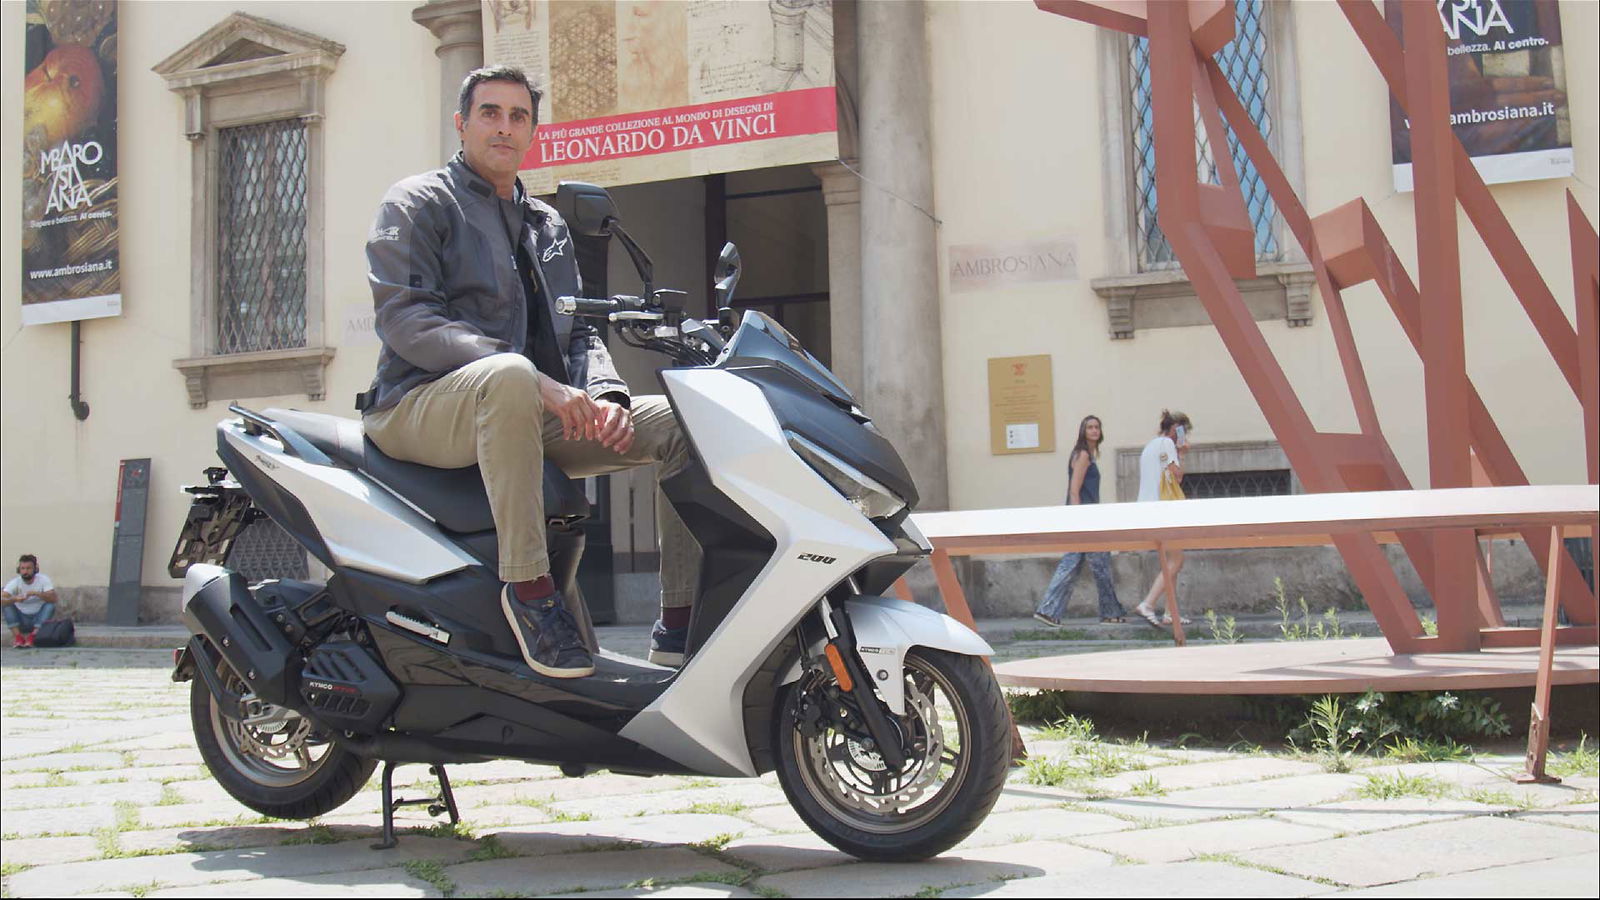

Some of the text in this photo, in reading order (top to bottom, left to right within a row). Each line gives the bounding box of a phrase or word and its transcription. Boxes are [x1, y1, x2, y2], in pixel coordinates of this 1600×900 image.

[1447, 37, 1549, 56] bellezza. Al centro.
[538, 101, 774, 141] LA PIÙ GRANDE COLLEZIONE AL MONDO DI DISEGNI DI
[1405, 102, 1555, 129] ambrosiana.it
[540, 112, 777, 163] LEONARDO DA VINCI
[30, 260, 113, 280] www.ambrosiana.it
[951, 251, 1077, 277] AMBROSIANA
[797, 553, 837, 565] 200
